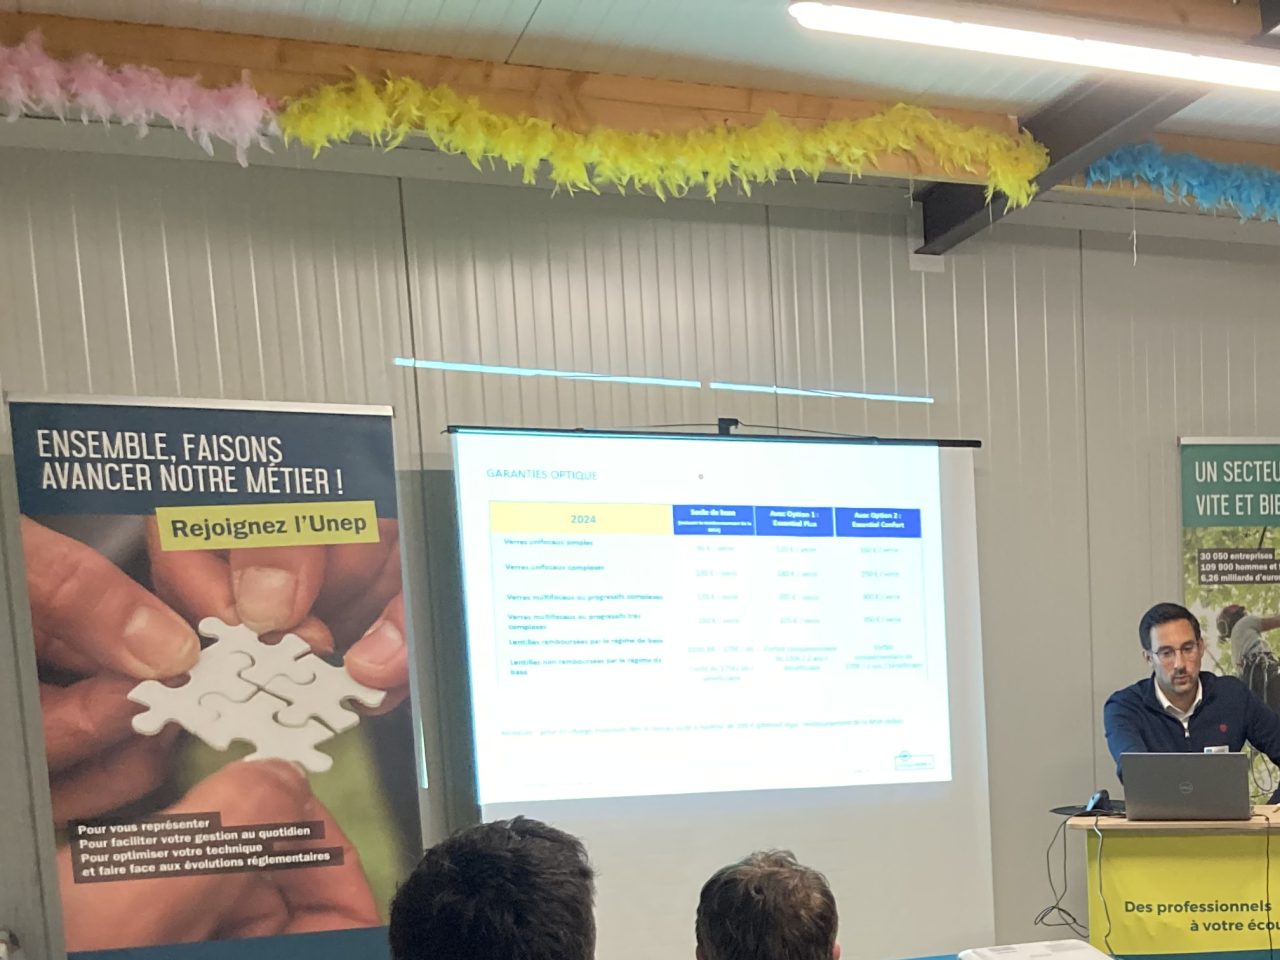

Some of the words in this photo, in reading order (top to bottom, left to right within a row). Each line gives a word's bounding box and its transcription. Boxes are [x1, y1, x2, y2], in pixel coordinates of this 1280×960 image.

[36, 429, 177, 463] ENSEMBLE,
[182, 433, 283, 463] FAISONS
[42, 462, 152, 491] AVANCER
[160, 464, 238, 493] NOTRE
[246, 461, 330, 495] MÉTIER
[336, 468, 344, 495] !
[486, 468, 548, 480] GARANTIES
[550, 470, 598, 481] OPTIQUE
[1195, 460, 1217, 482] UN
[1196, 494, 1230, 516] VITE
[1235, 494, 1254, 515] ET
[171, 517, 287, 541] Rejoignez
[294, 514, 367, 535] l'Unep
[570, 515, 597, 524] 2024
[1200, 552, 1211, 560] 30
[1230, 552, 1273, 562] entreprises
[1235, 562, 1268, 571] hommes
[1220, 573, 1253, 582] milliards
[78, 824, 106, 835] Pour
[110, 823, 138, 833] vous
[141, 818, 210, 833] représenter
[79, 838, 107, 849] Pour
[111, 835, 157, 848] faciliter
[161, 834, 191, 844] votre
[195, 830, 239, 844] gestion
[241, 831, 256, 839] au
[258, 826, 311, 839] quotidien
[81, 852, 109, 863] Pour
[113, 848, 169, 862] optimiser
[172, 846, 203, 857] votre
[206, 842, 263, 856] technique
[82, 867, 96, 877] et
[99, 863, 126, 875] faire
[130, 862, 156, 873] face
[159, 862, 181, 872] aux
[184, 856, 244, 870] évolutions
[247, 851, 331, 867] réglementaires
[1124, 901, 1153, 913] Des
[1157, 899, 1272, 915] professionnels
[1190, 920, 1199, 931] à
[1203, 919, 1243, 931] votre
